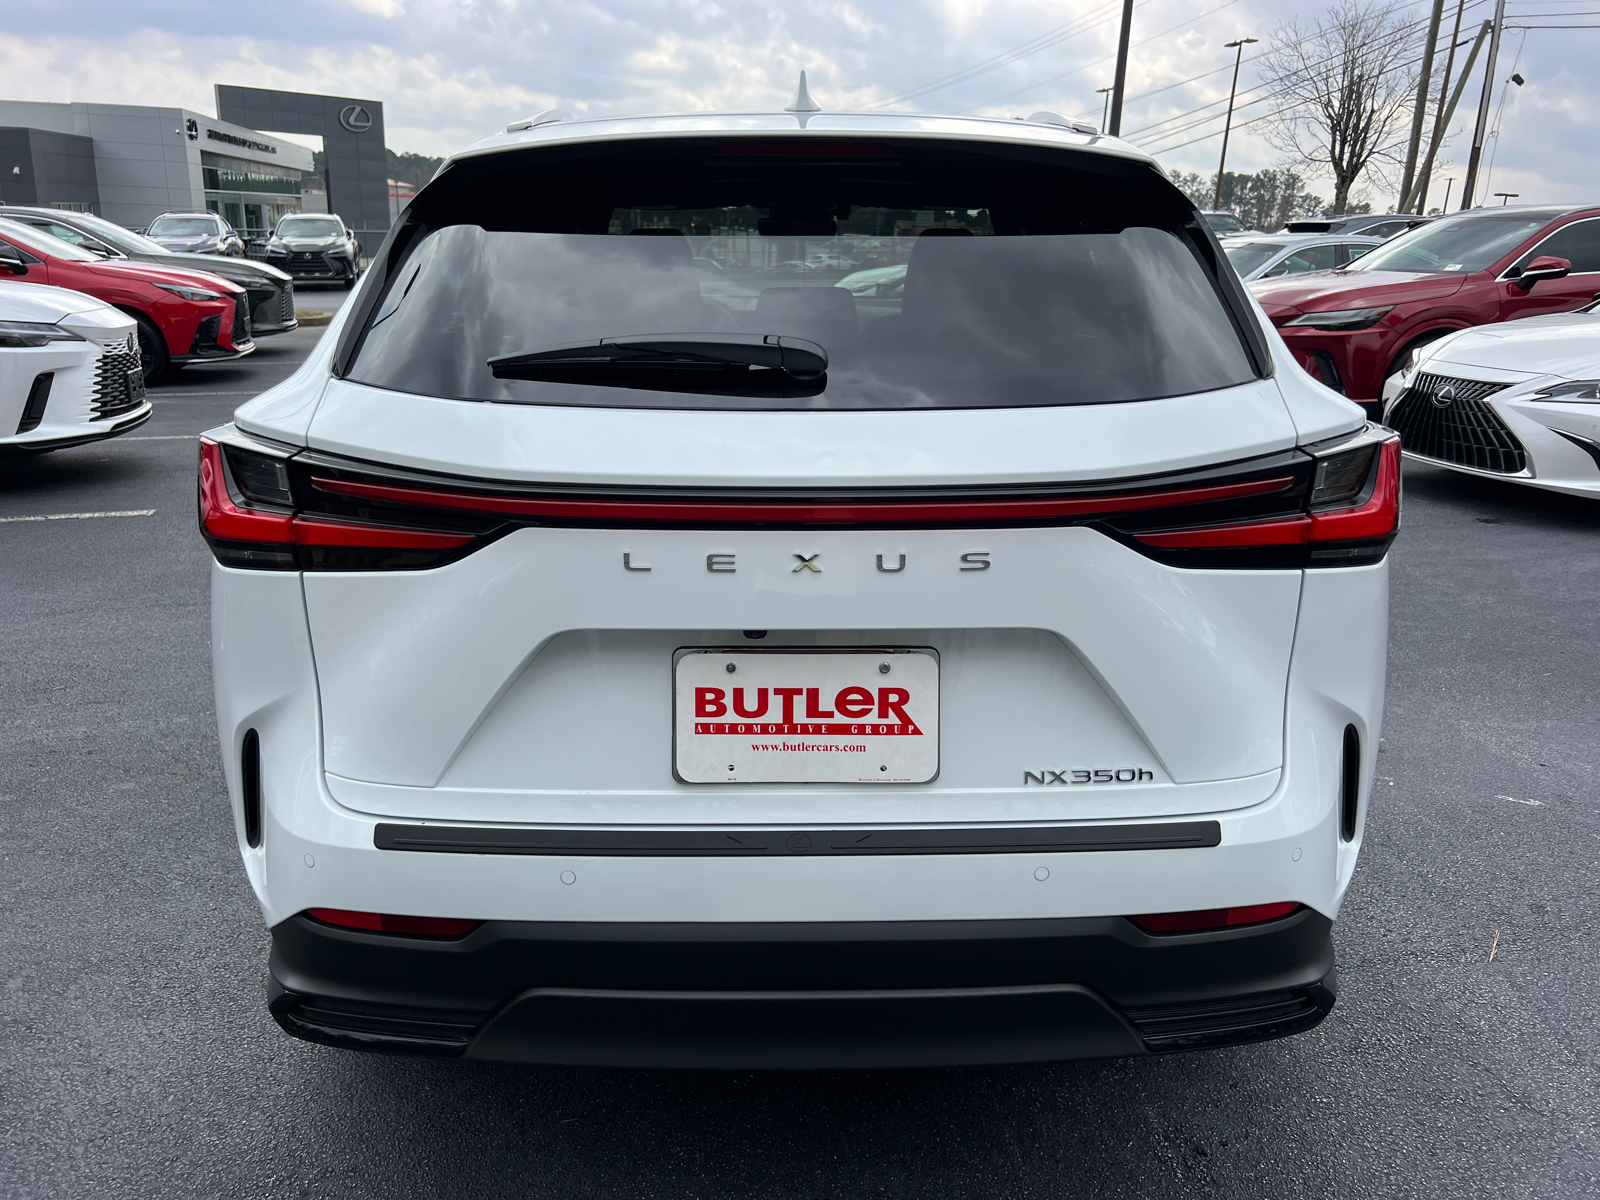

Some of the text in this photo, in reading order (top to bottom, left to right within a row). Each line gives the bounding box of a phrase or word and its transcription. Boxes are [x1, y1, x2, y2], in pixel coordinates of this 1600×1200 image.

[623, 551, 991, 573] LEXUS
[695, 724, 915, 734] AUTOMOTIVE GROUP
[751, 742, 867, 753] www.butlercars.com
